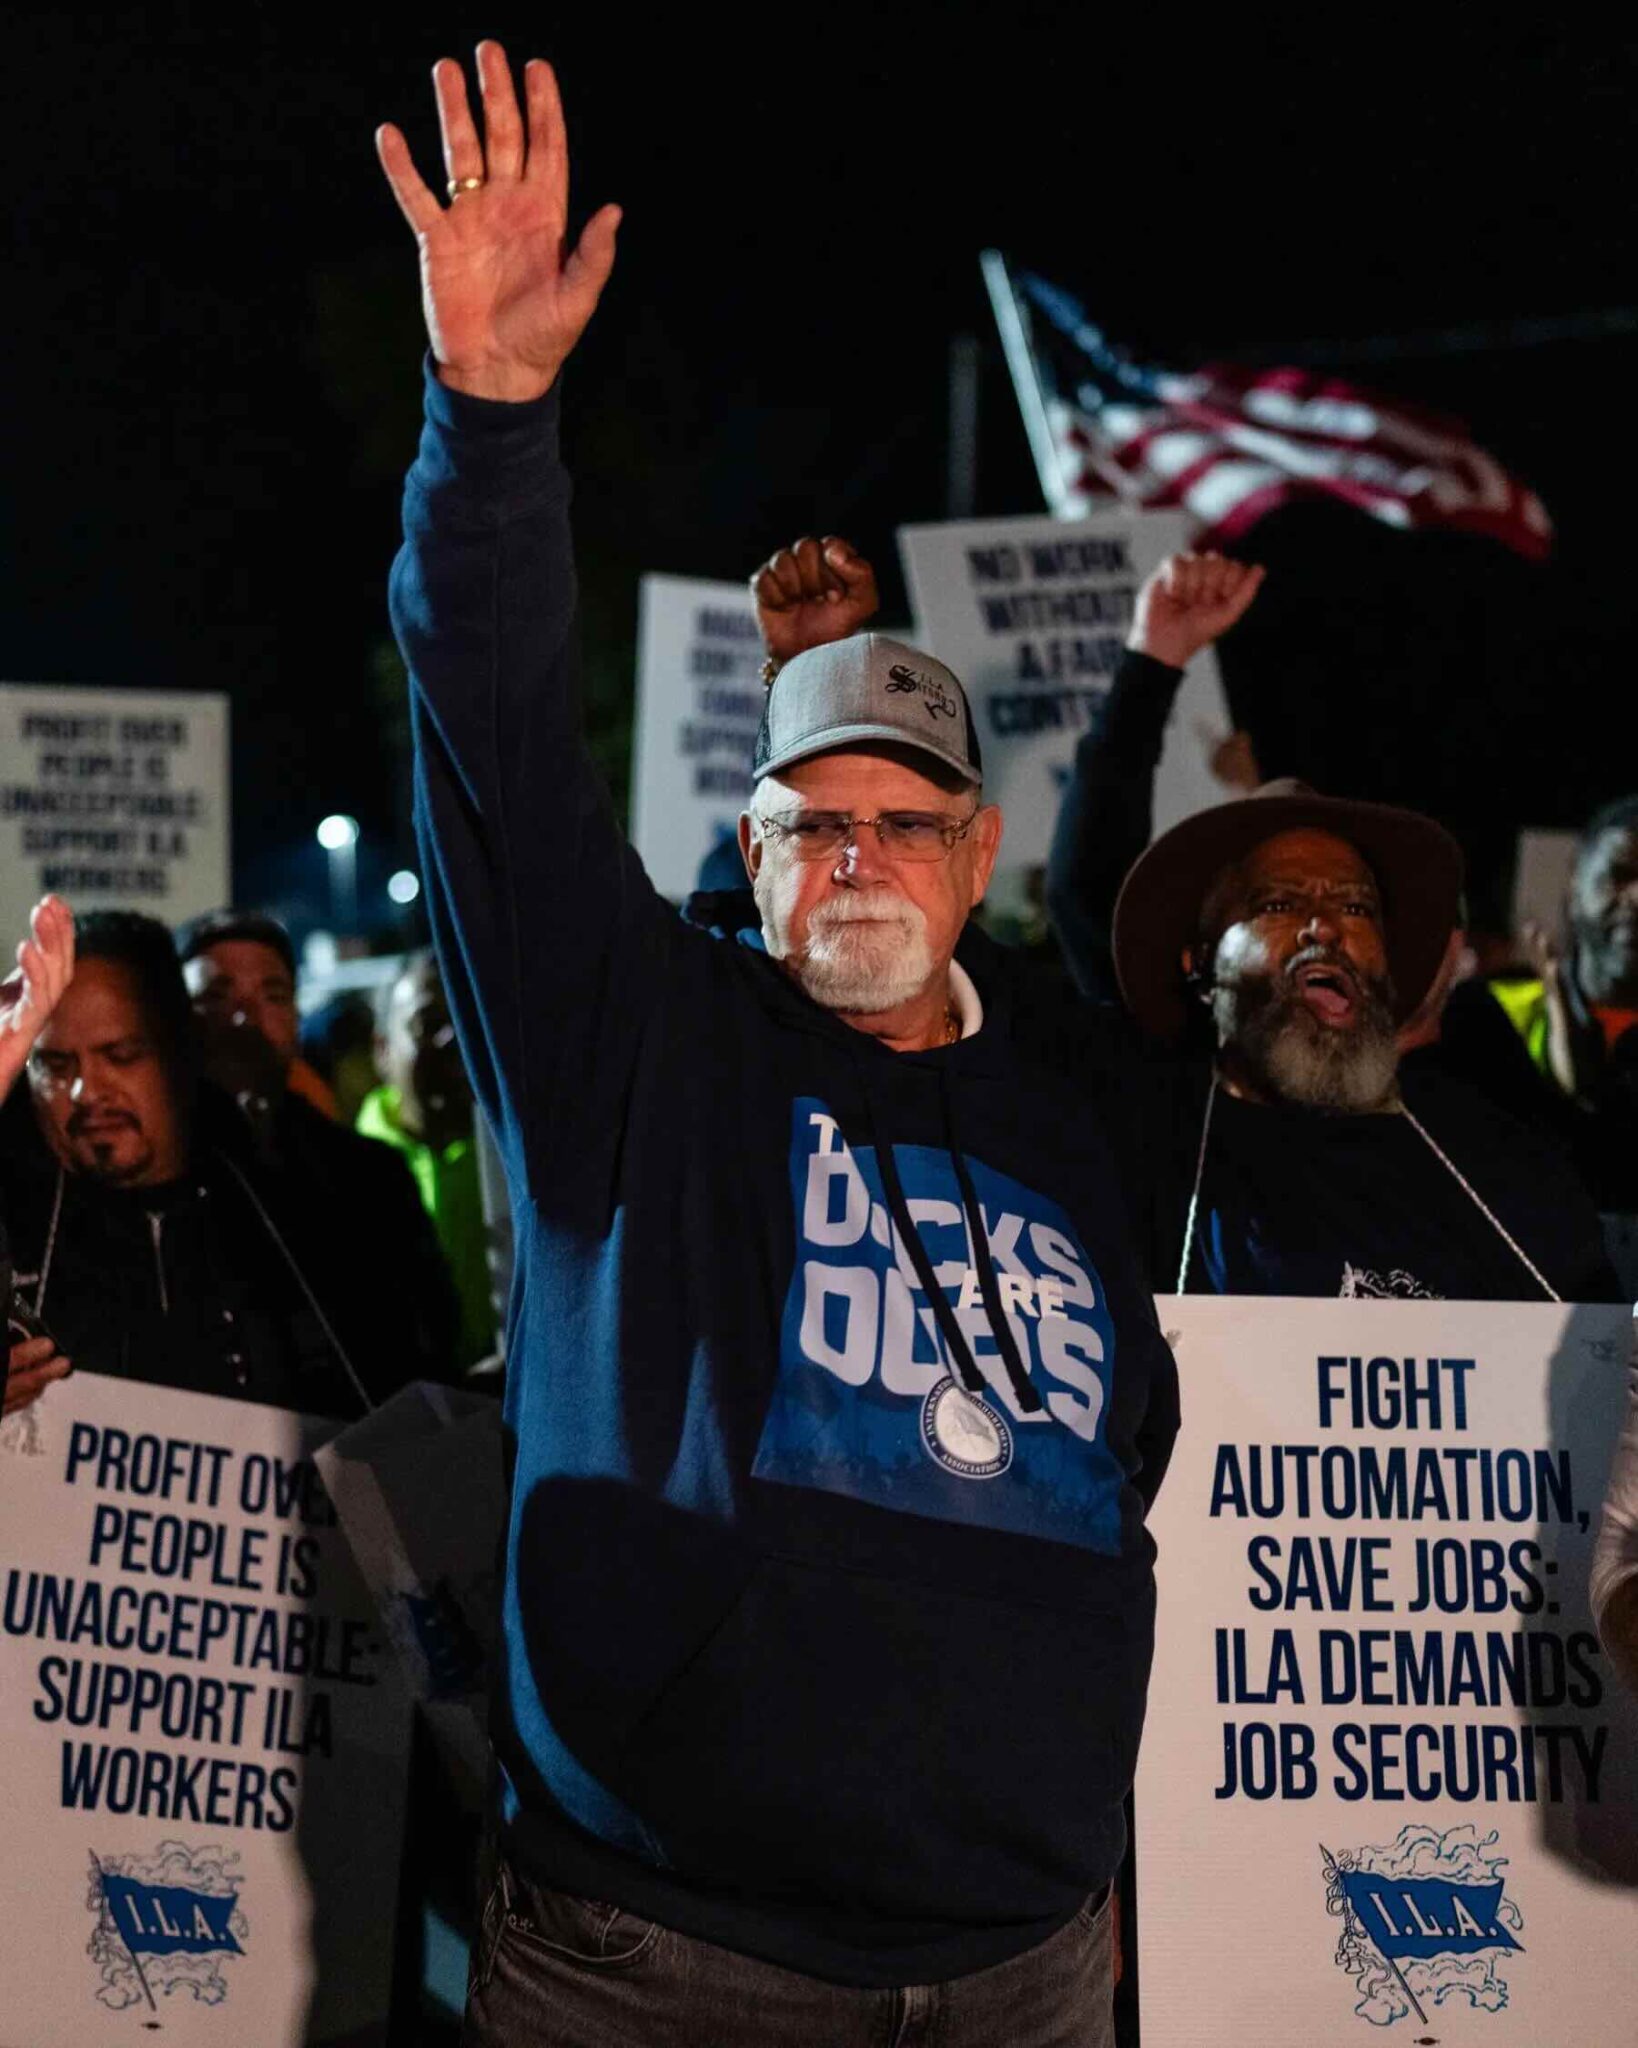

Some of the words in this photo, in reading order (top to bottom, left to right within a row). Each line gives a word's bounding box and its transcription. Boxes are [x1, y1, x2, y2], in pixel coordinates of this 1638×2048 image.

[1317, 1356, 1476, 1430] FIGHT
[64, 1421, 233, 1507] PROFIT
[239, 1453, 338, 1528] OVE
[1209, 1444, 1590, 1533] AUTOMATION,
[88, 1503, 268, 1591] PEOPLE
[276, 1534, 320, 1599] IS
[1247, 1535, 1394, 1612] SAVE
[1408, 1538, 1561, 1614] JOBS:
[33, 1656, 256, 1746] SUPPORT
[263, 1687, 333, 1759] ILA
[1215, 1628, 1305, 1704] ILA
[1319, 1629, 1601, 1708] DEMANDS
[60, 1740, 297, 1833] WORKERS
[1215, 1722, 1318, 1800] JOB
[1333, 1724, 1609, 1805] SECURITY
[124, 1894, 226, 1941] I.L.A.
[1369, 1893, 1498, 1937] I.L.A.
